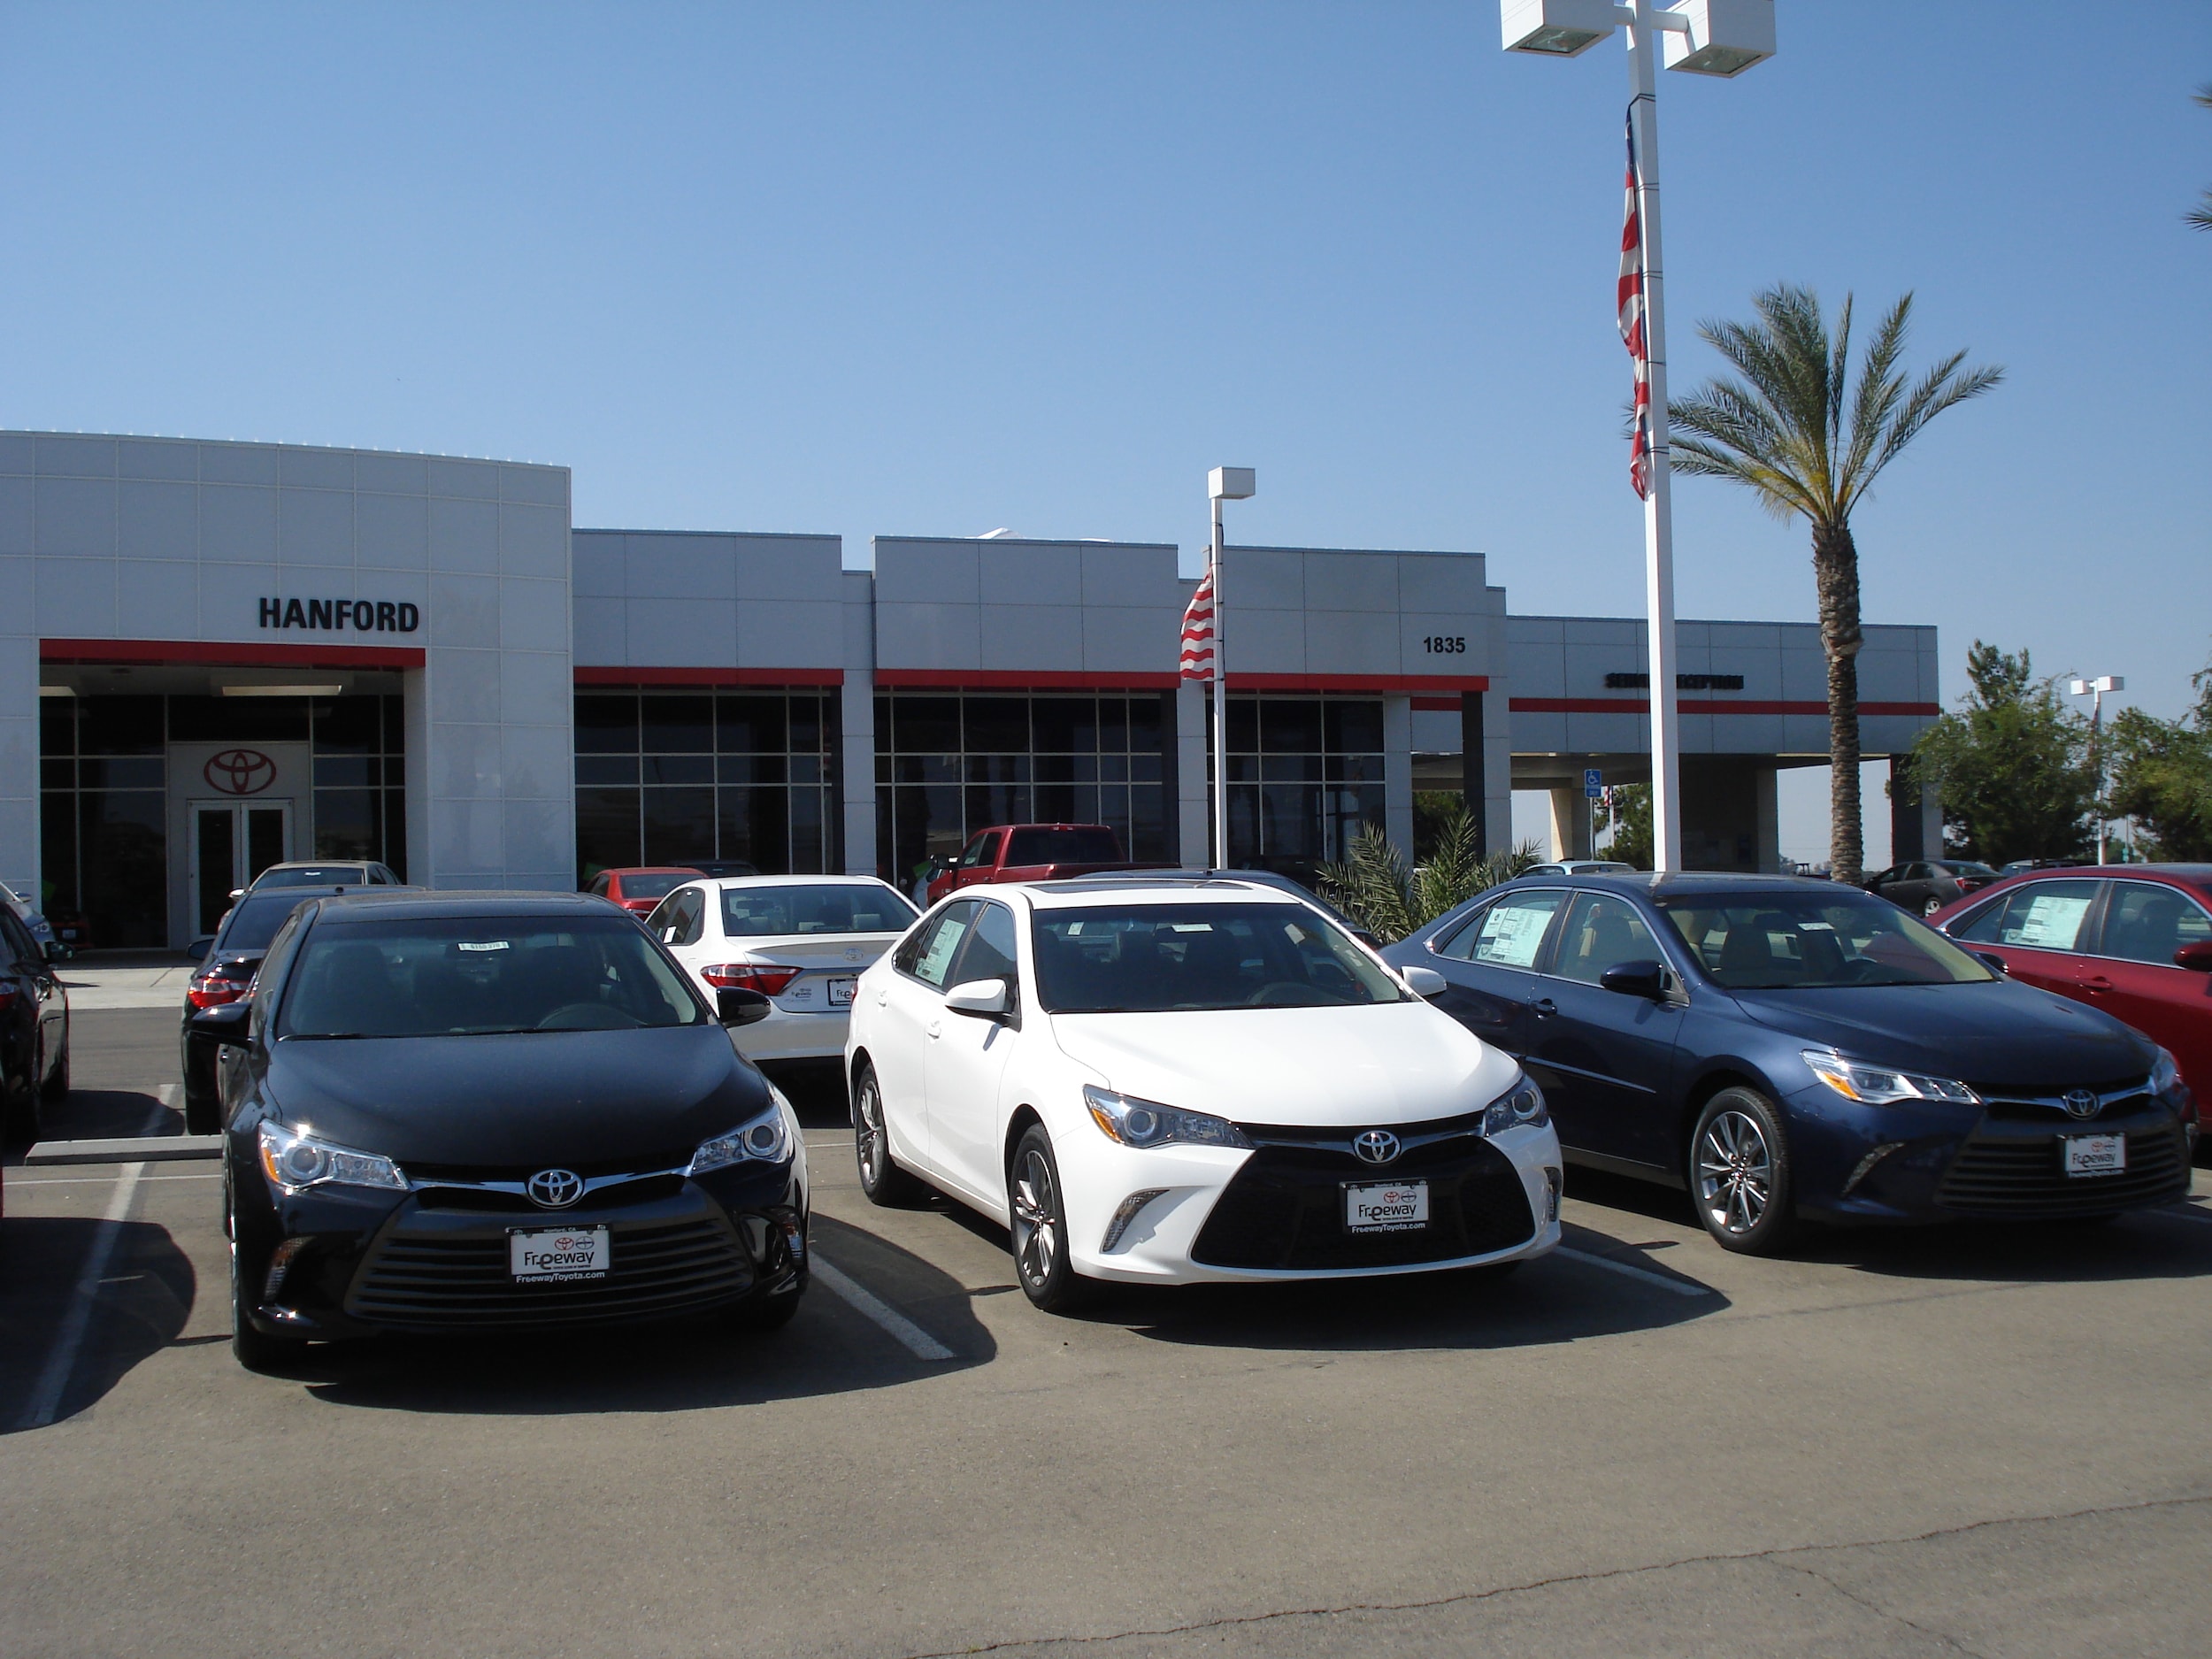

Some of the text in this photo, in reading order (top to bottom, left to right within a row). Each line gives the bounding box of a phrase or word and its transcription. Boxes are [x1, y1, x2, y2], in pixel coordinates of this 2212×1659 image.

[259, 597, 419, 633] HANFORD
[1423, 636, 1466, 654] 1835
[1358, 1204, 1417, 1221] Freeway
[1351, 1222, 1426, 1233] FreewayToyota.com
[524, 1251, 595, 1270] Freeway
[516, 1271, 605, 1283] FreewayToyota.com
